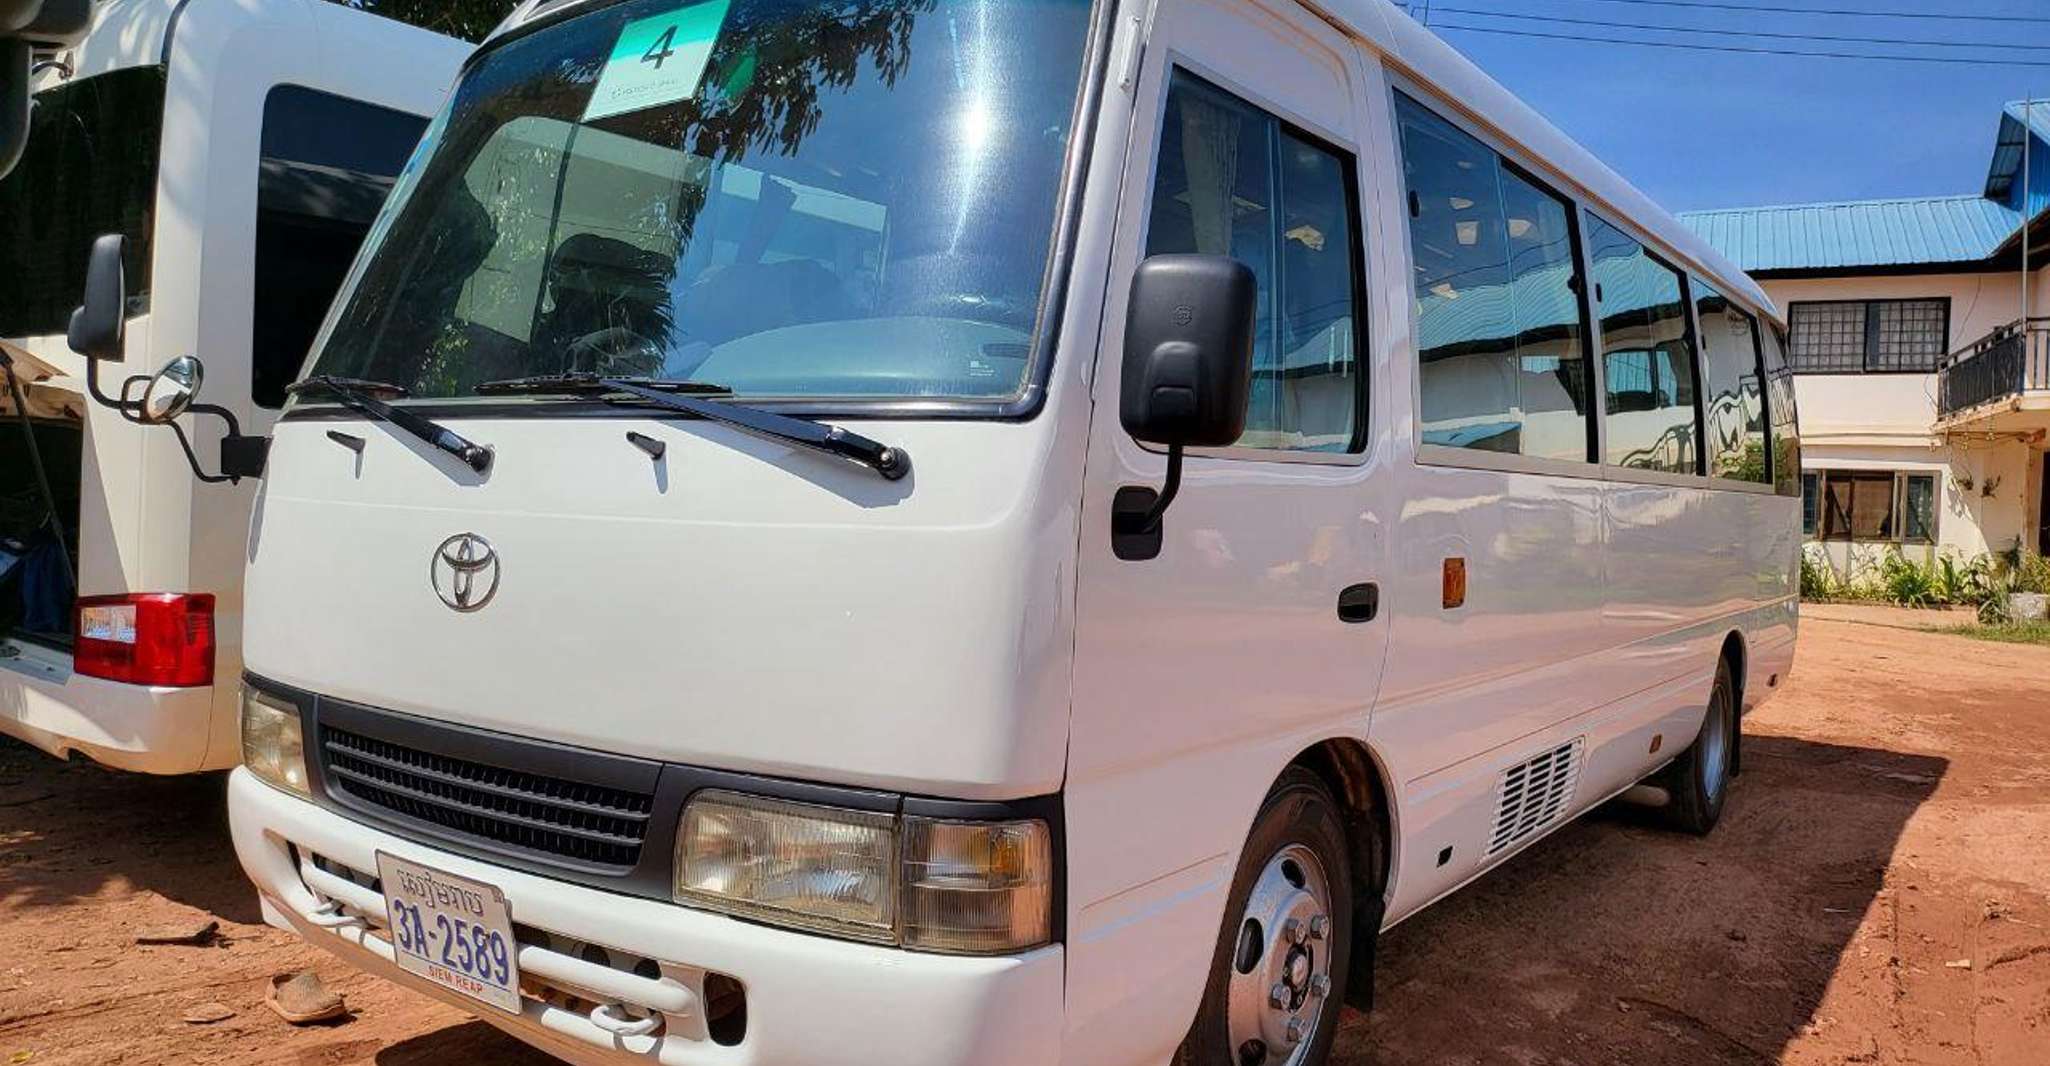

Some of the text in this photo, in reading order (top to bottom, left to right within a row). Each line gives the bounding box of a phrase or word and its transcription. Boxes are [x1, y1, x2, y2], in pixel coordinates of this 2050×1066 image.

[640, 24, 680, 70] 4
[394, 899, 509, 985] 3A-2589
[428, 965, 484, 993] SIEM REAP
